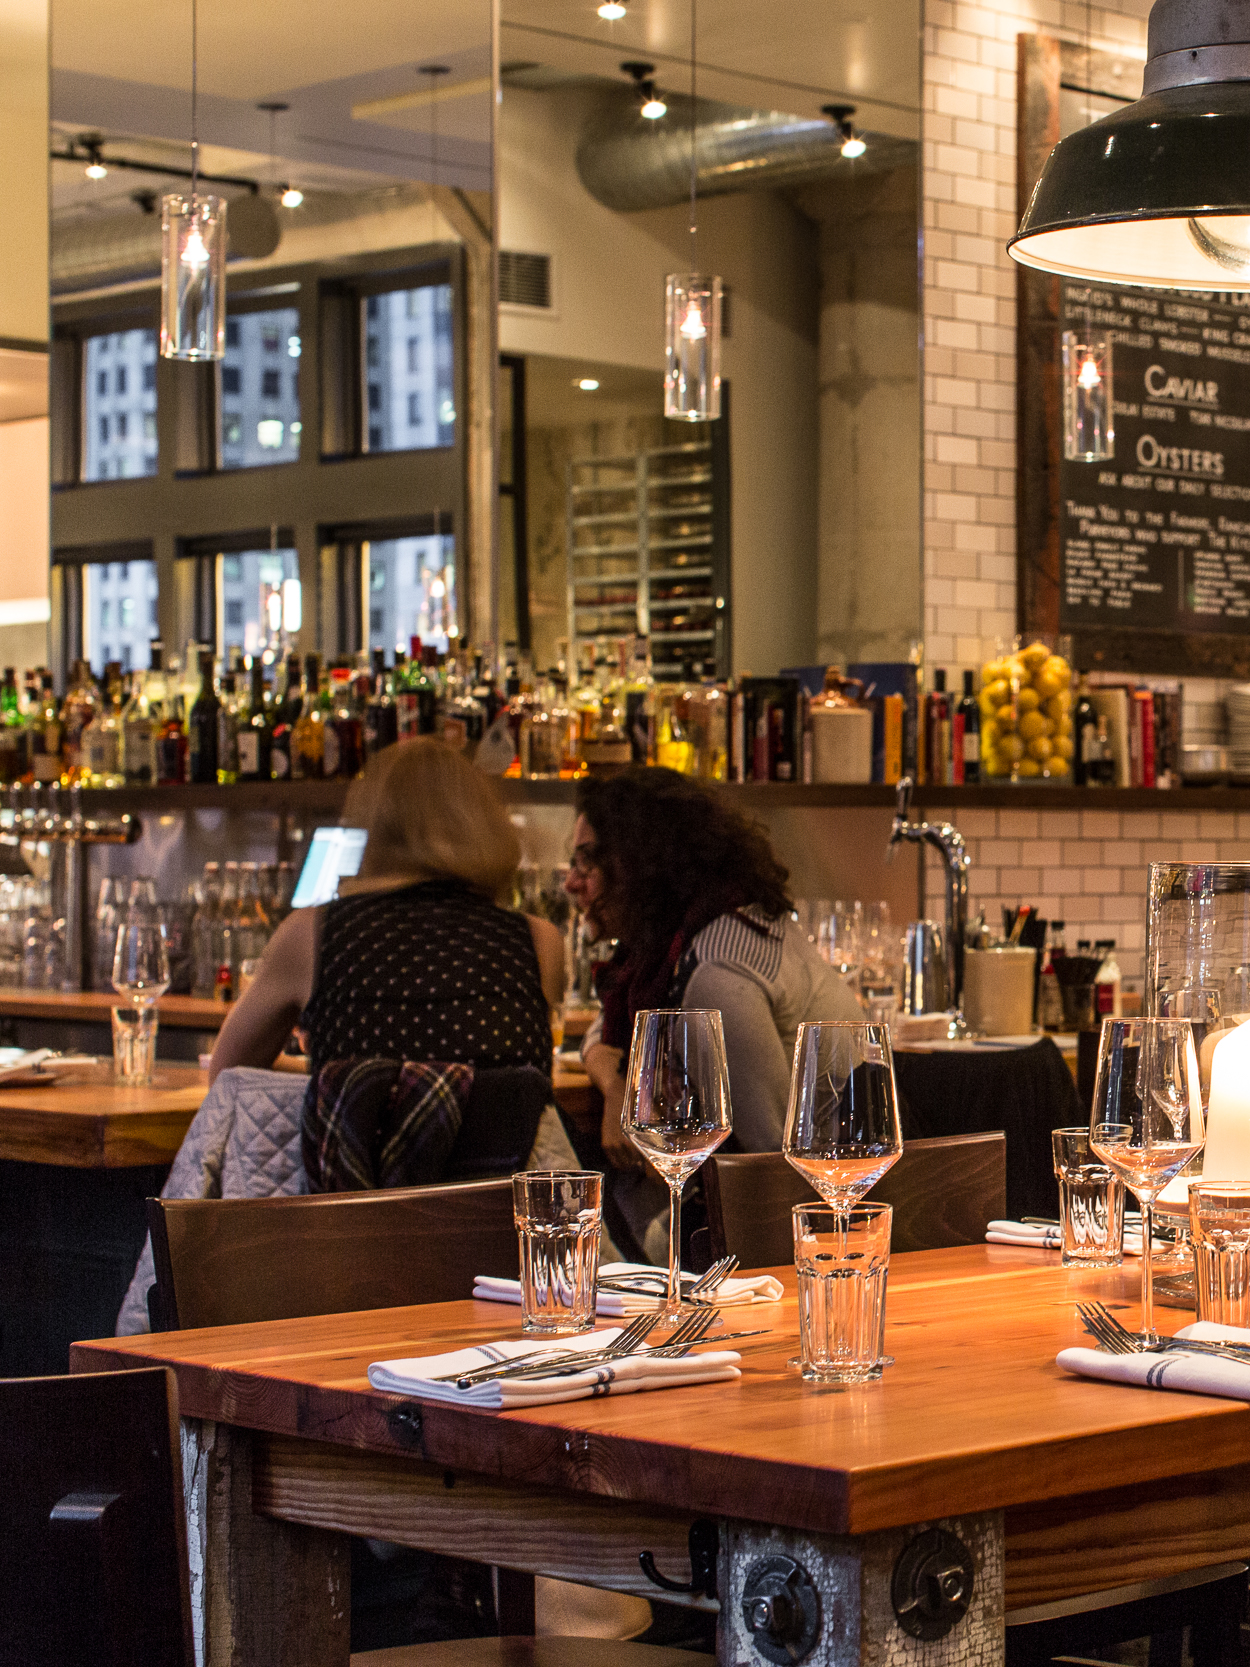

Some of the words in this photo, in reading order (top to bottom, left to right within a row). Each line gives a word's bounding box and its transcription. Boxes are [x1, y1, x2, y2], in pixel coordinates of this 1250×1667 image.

[1144, 364, 1219, 403] CAVIAR
[1136, 434, 1225, 476] OYSTERS
[1098, 503, 1120, 522] YOU
[1124, 509, 1140, 524] TO
